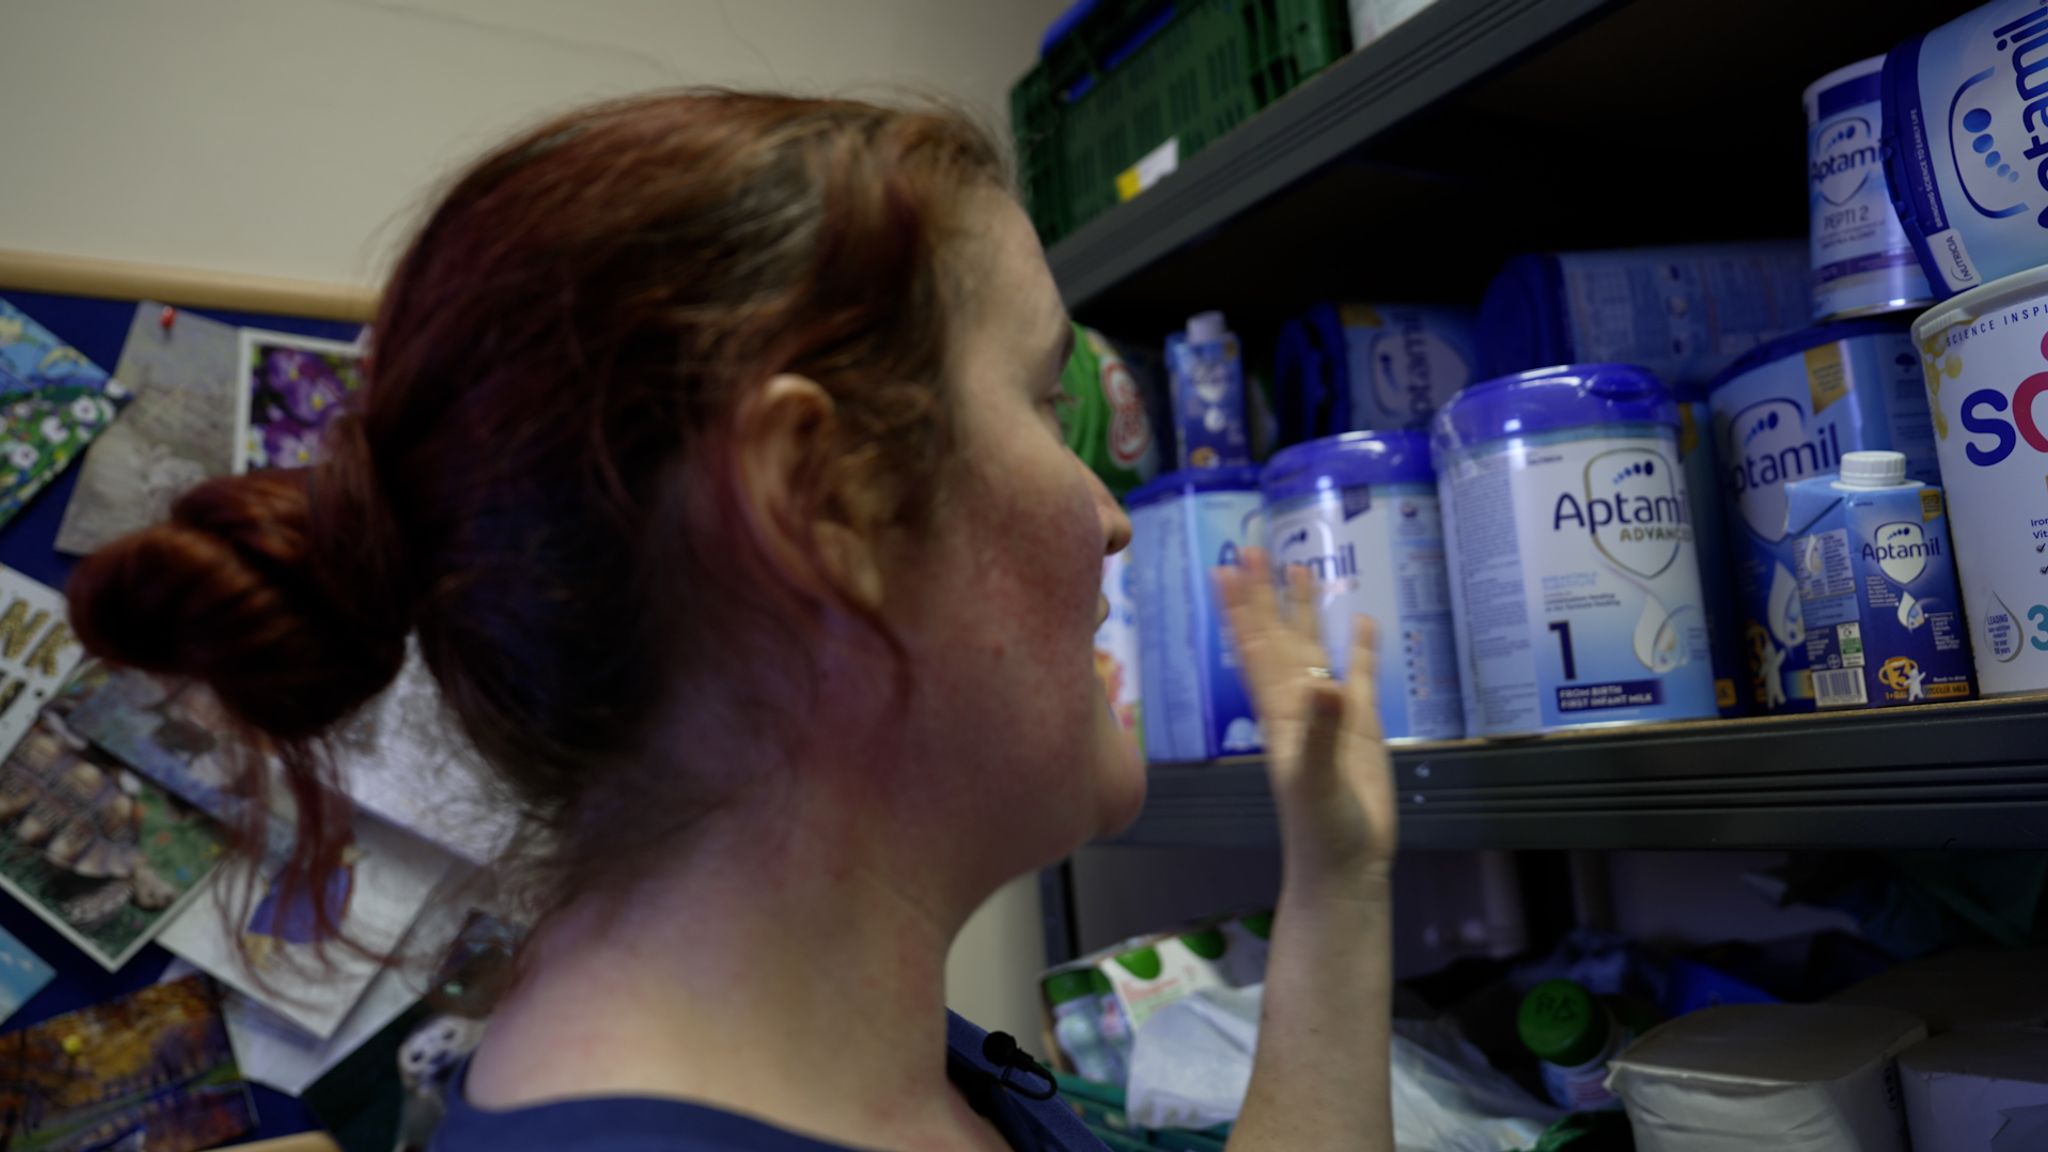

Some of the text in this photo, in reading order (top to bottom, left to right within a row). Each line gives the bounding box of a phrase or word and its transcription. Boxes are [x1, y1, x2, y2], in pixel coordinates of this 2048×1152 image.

[1910, 124, 1924, 148] EARLY
[1916, 148, 1926, 159] TO
[1918, 160, 1933, 191] SCIENCE
[1860, 205, 1870, 221] 2
[1943, 235, 1971, 278] NUTRICIA
[1947, 320, 1994, 347] SCIENCE
[1862, 538, 1941, 563] Aptamil
[1548, 620, 1577, 680] 1
